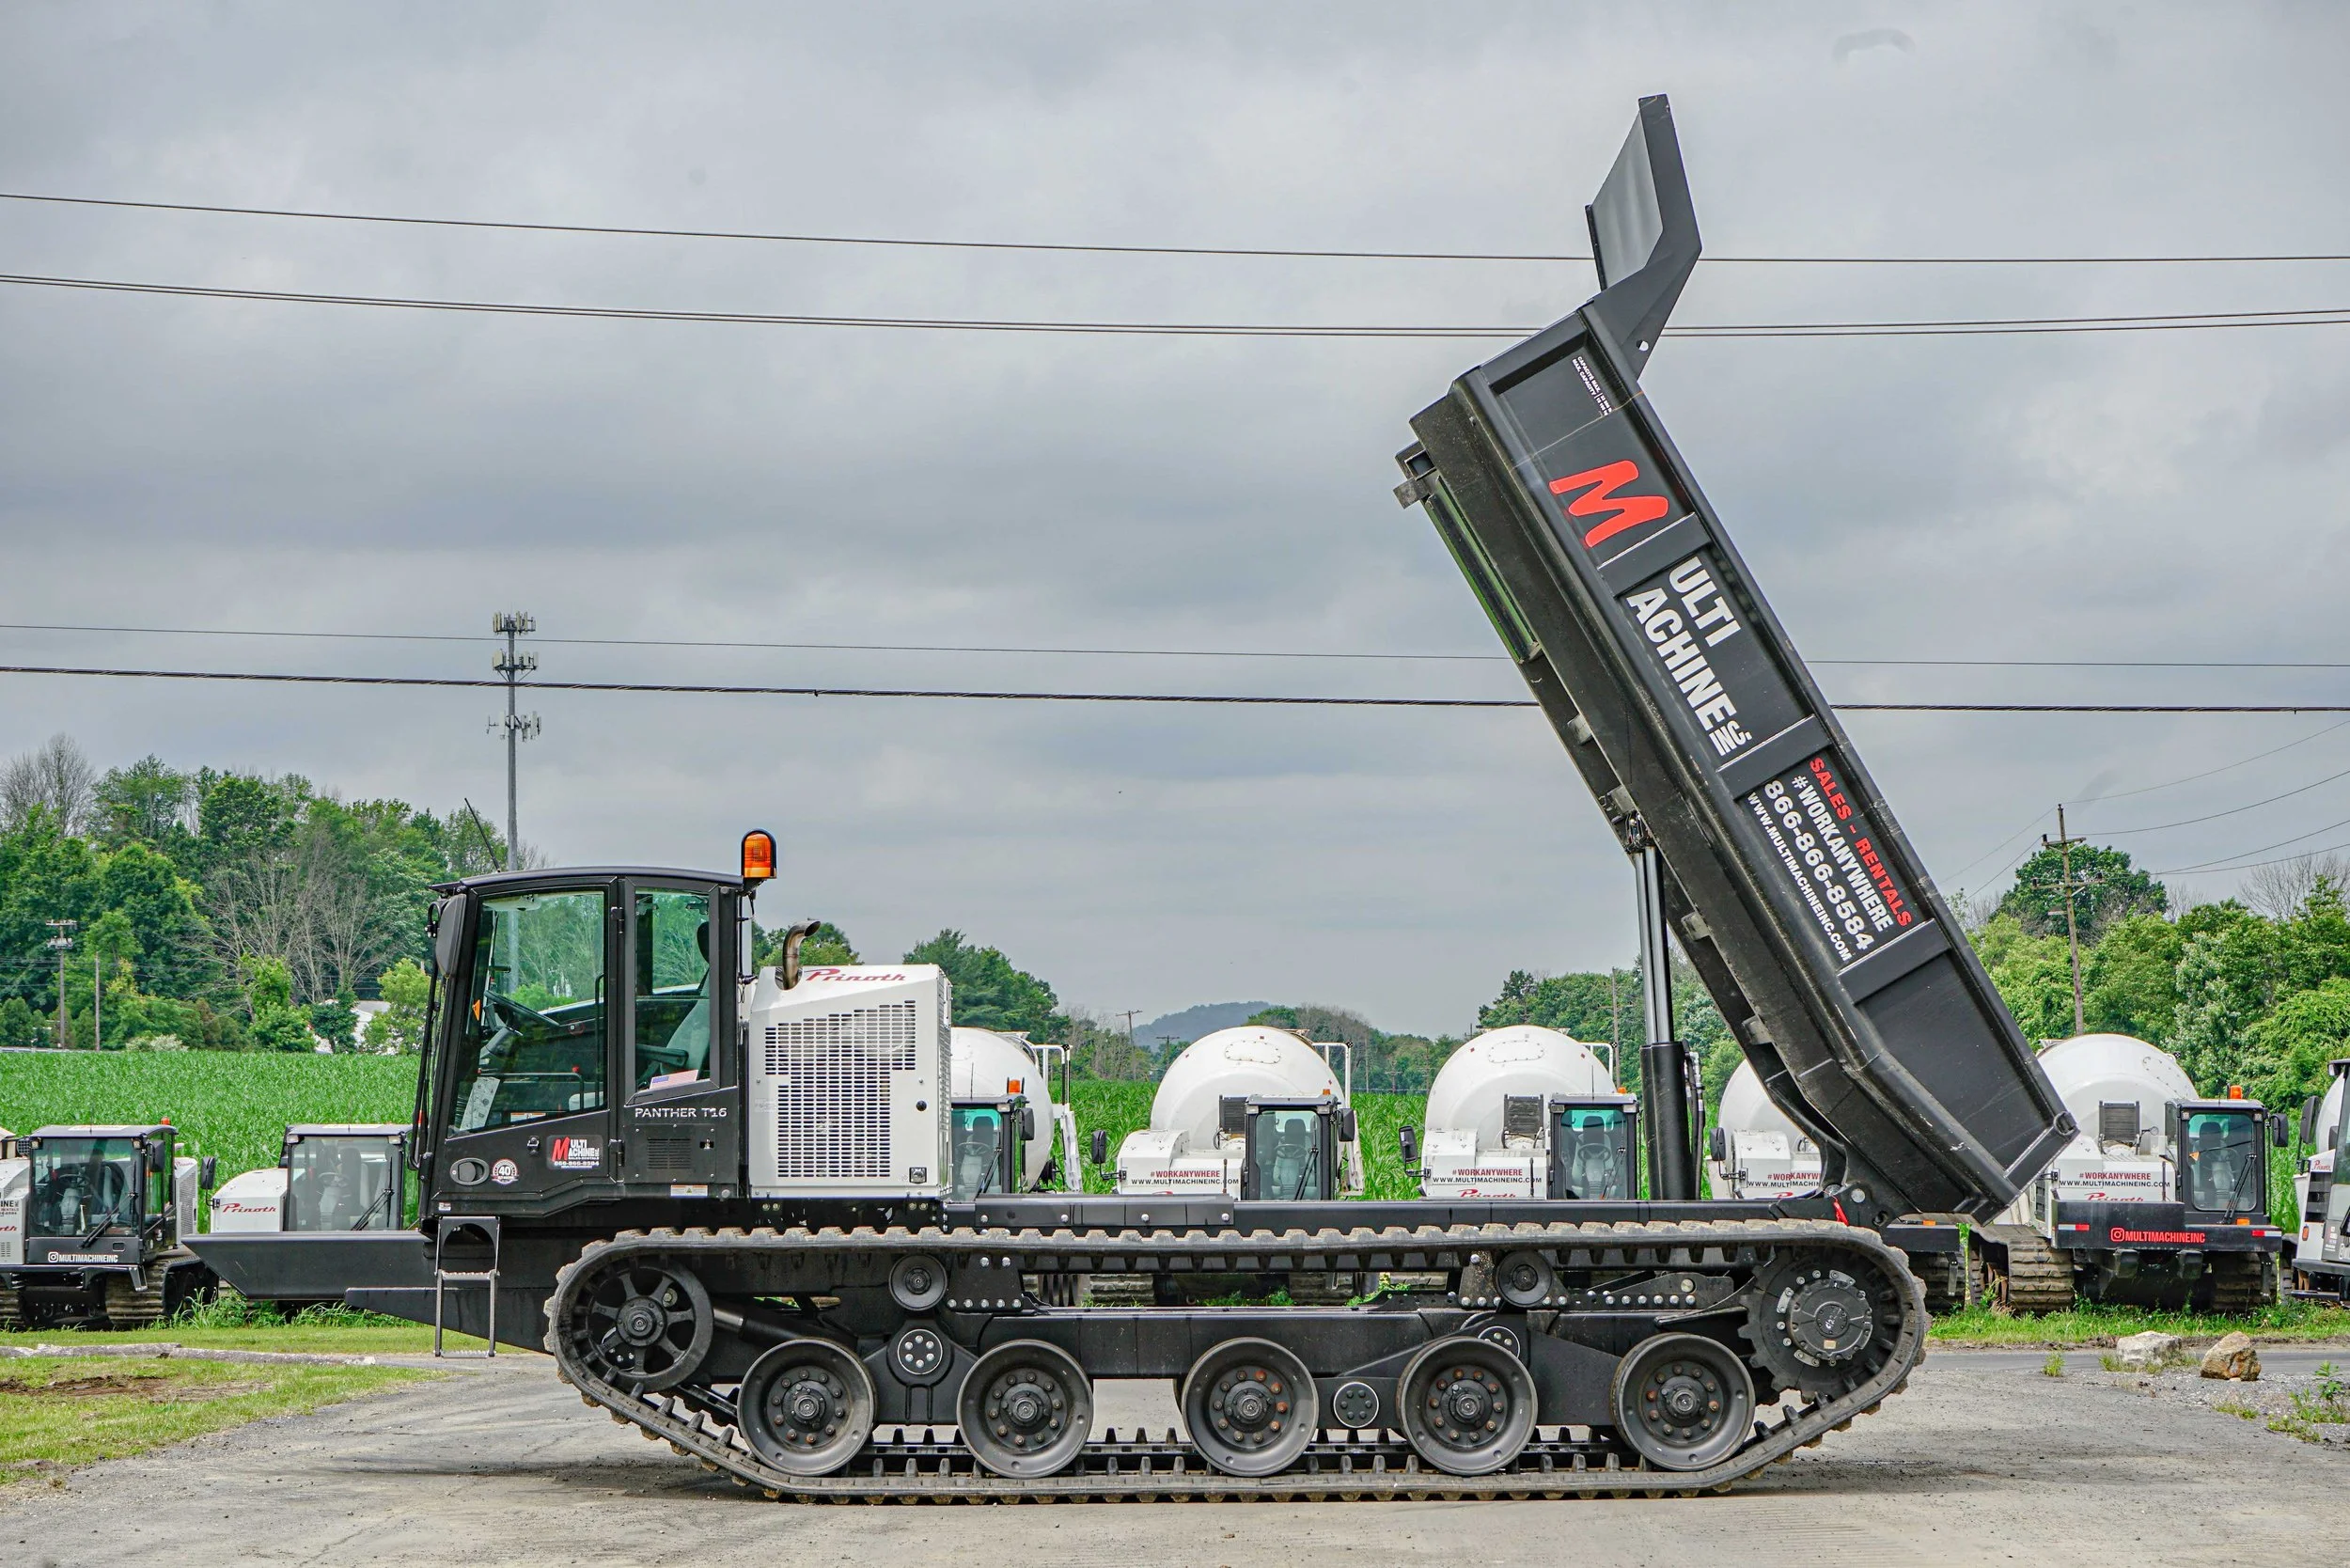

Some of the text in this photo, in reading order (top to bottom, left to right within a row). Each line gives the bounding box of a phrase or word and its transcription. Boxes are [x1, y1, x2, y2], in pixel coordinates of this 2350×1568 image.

[1708, 720, 1752, 757] INC.
[1810, 757, 1852, 820] SALES
[1855, 837, 1912, 927] RENTALS
[1792, 775, 1894, 932] #WORKANYWHERE
[1764, 779, 1874, 950] 866-866-8584
[1747, 792, 1853, 962] WWW.MULTIMACHINEINC.COM
[806, 968, 906, 981] Prinoth
[634, 1107, 728, 1118] PANTHER T16
[498, 1166, 511, 1176] 40
[222, 1202, 277, 1213] Prinoth
[2125, 1231, 2205, 1244] MULTIMACHINEINC
[58, 1254, 118, 1262] MULTIMACHINEINC
